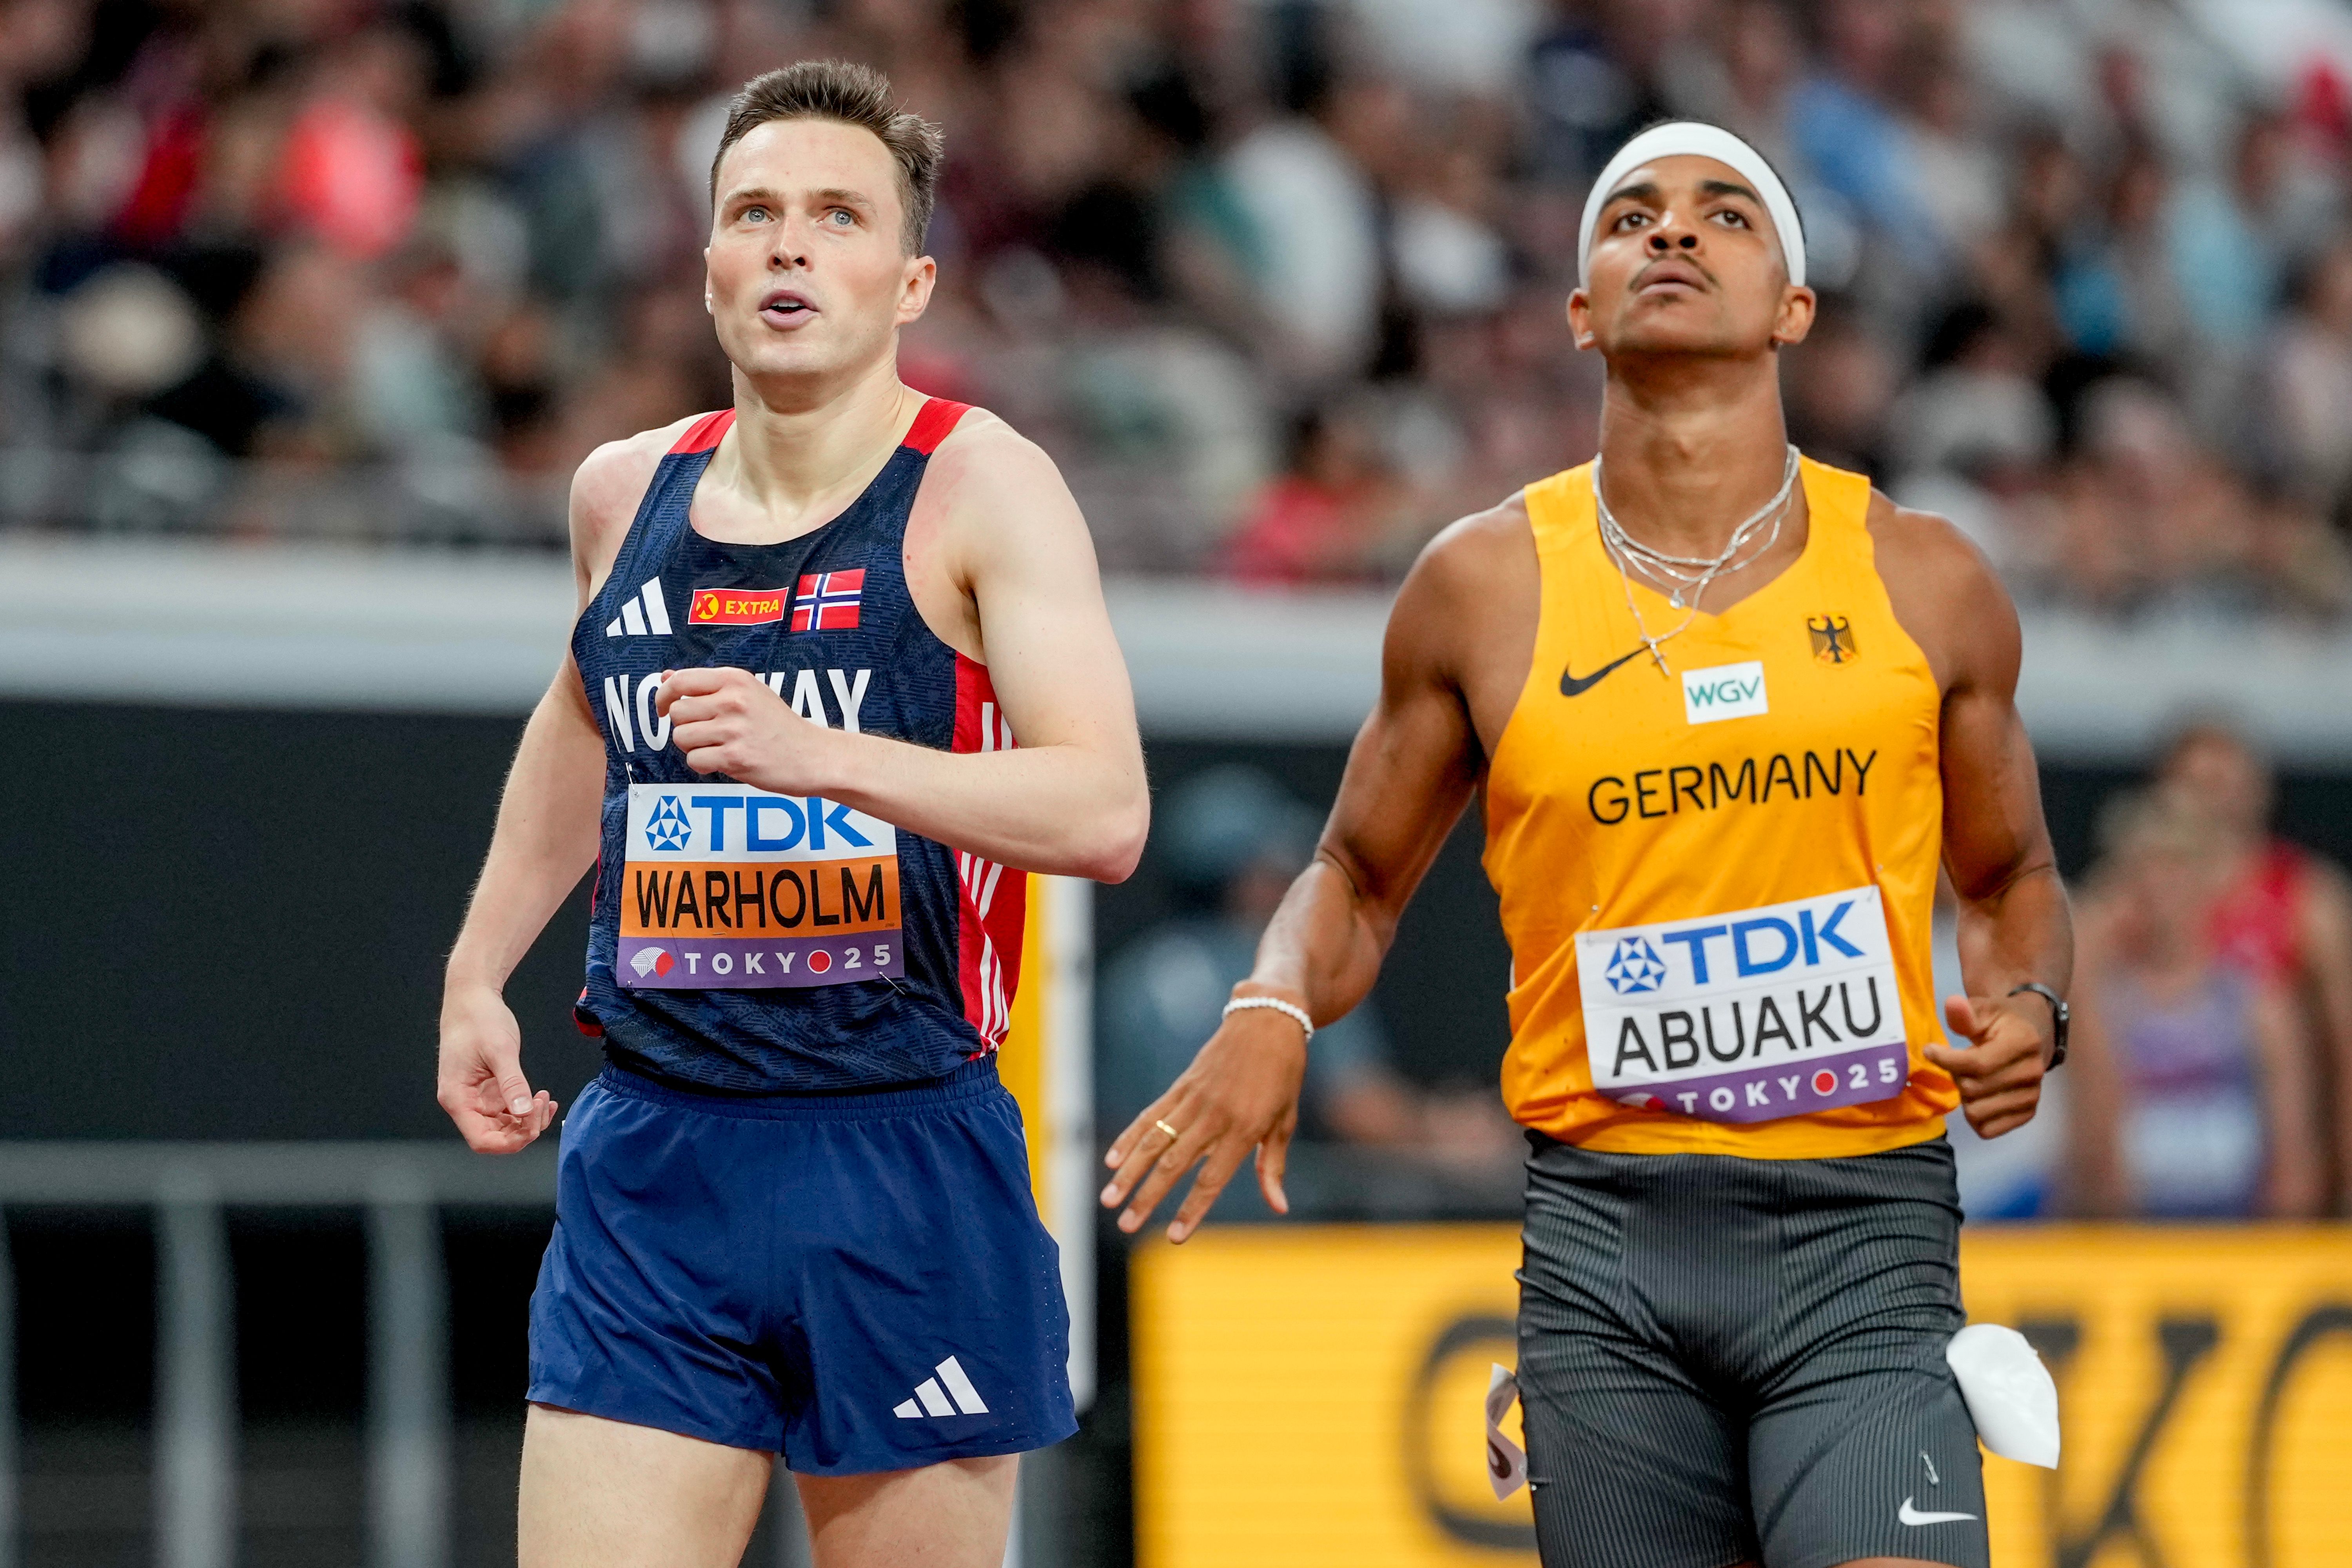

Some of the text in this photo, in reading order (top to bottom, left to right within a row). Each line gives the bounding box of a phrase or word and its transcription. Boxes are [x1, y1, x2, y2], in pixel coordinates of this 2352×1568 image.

[725, 599, 779, 615] EXTRA
[604, 669, 872, 753] NOAY
[1687, 676, 1760, 709] WGV
[1588, 748, 1877, 826] GERMANY
[691, 796, 874, 851] TDK
[636, 864, 886, 929] WARHOLM
[844, 944, 891, 969] 25
[1662, 900, 1866, 985] TDK
[1612, 976, 1882, 1077] ABUAKU
[1848, 1058, 1898, 1090] 25
